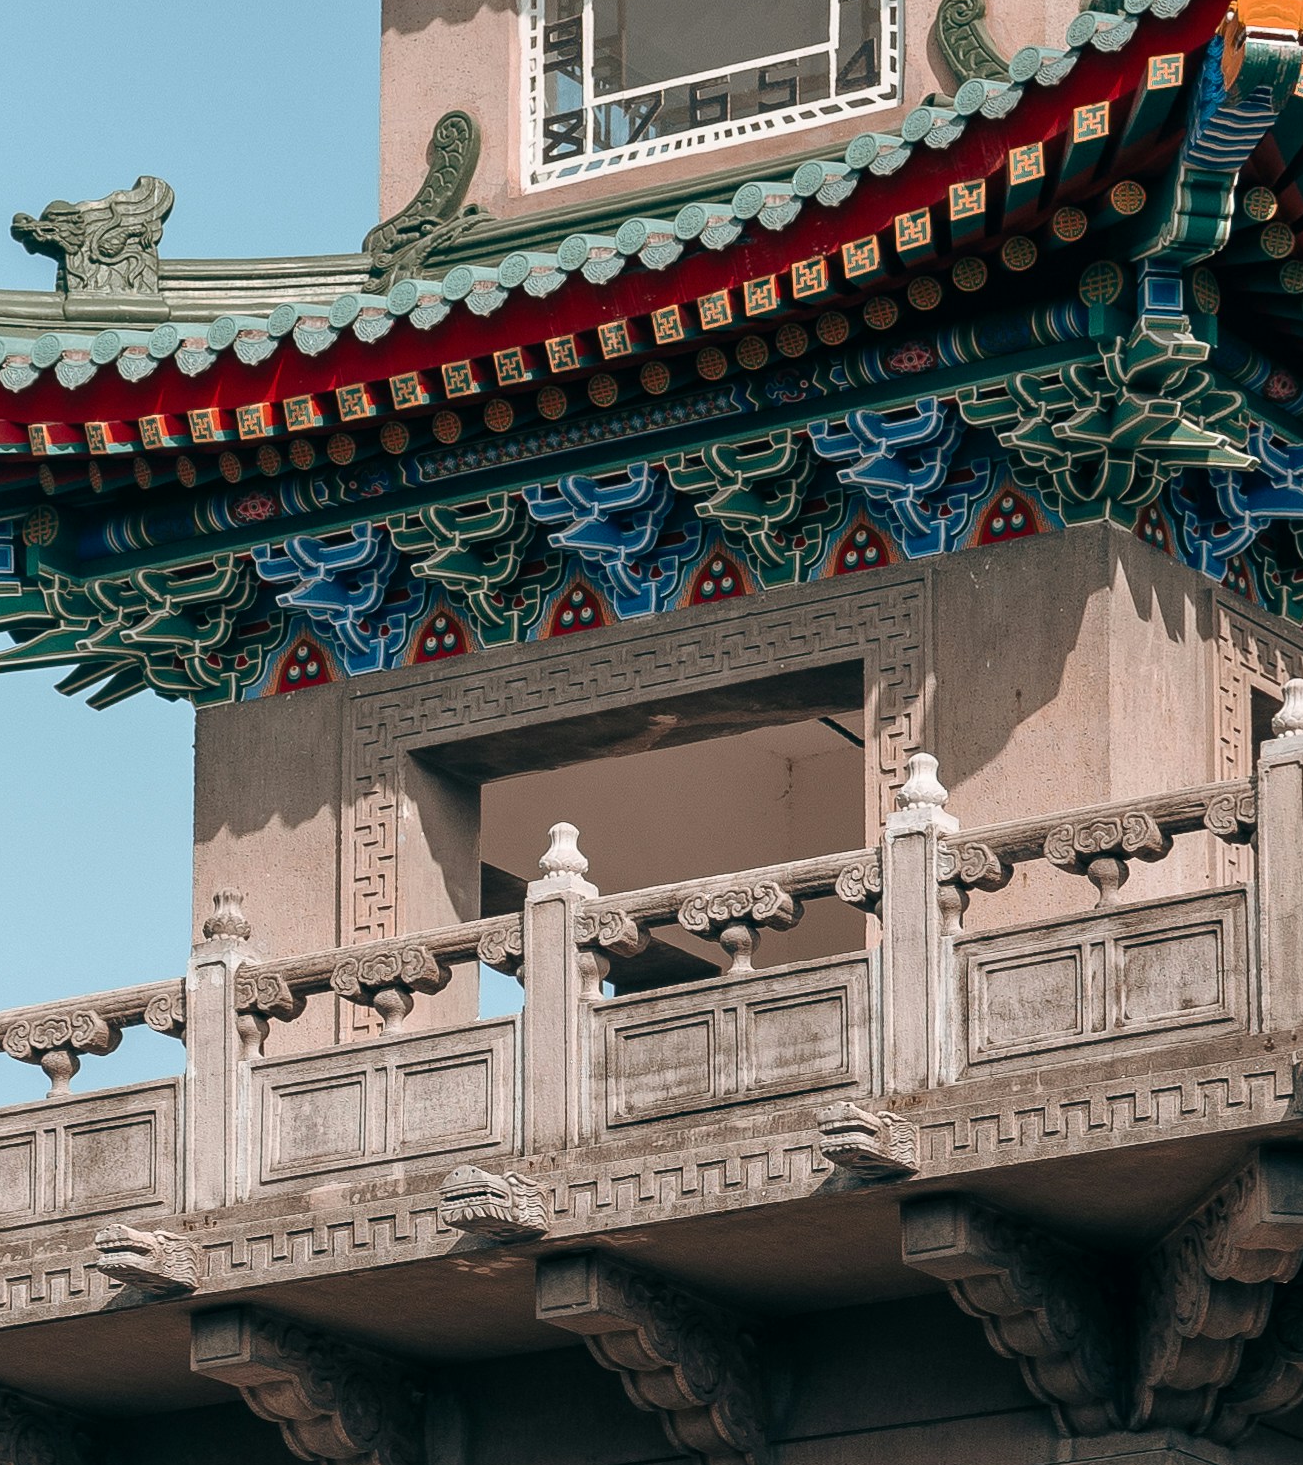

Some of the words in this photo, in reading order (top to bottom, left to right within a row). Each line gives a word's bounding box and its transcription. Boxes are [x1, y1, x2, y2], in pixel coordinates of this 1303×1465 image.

[544, 14, 582, 72] 9
[542, 107, 586, 164] 8
[625, 91, 664, 143] 7
[691, 77, 730, 125] 6
[758, 60, 799, 109] 5
[837, 38, 879, 93] 4
